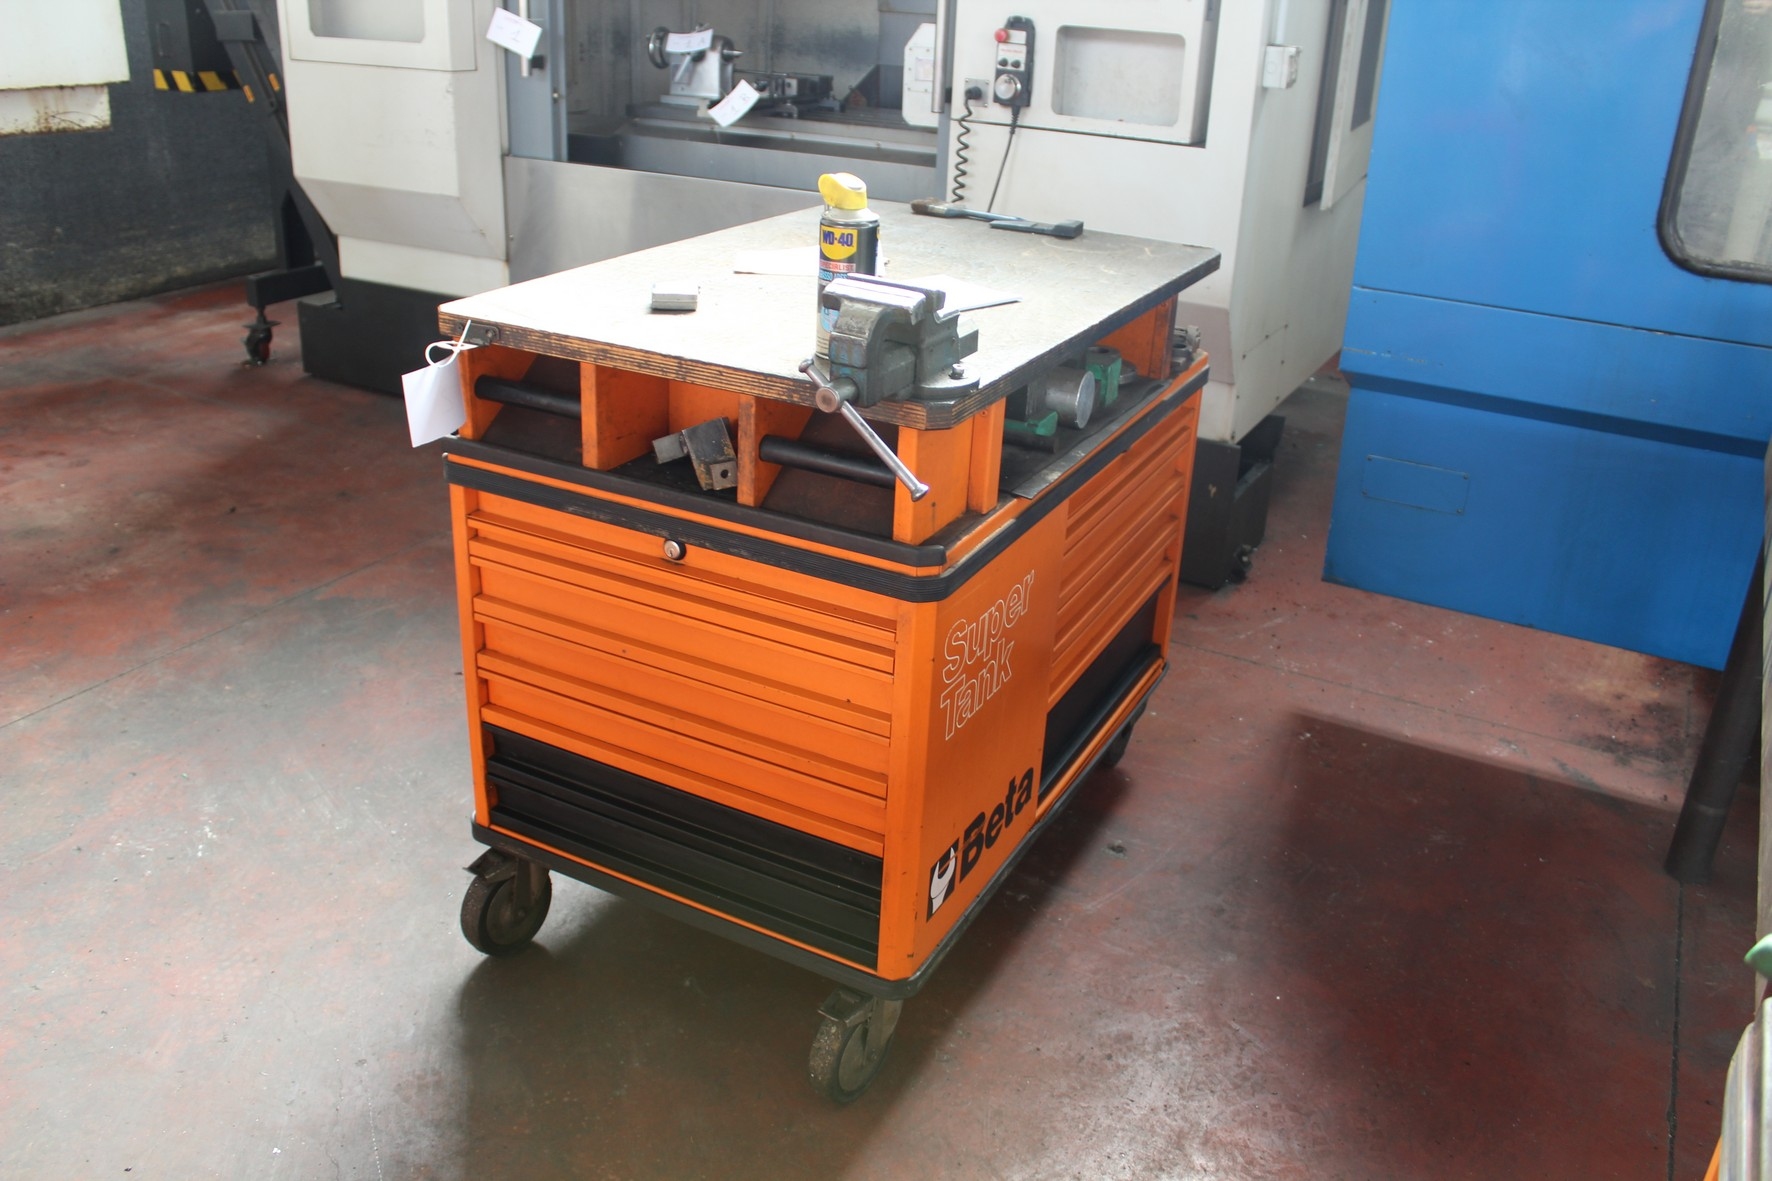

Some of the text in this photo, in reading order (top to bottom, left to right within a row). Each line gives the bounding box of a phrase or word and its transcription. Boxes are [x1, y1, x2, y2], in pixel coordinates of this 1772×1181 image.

[823, 230, 853, 247] WD-40
[942, 569, 1035, 684] Super
[940, 638, 1015, 741] Tank
[959, 767, 1034, 884] Beta
